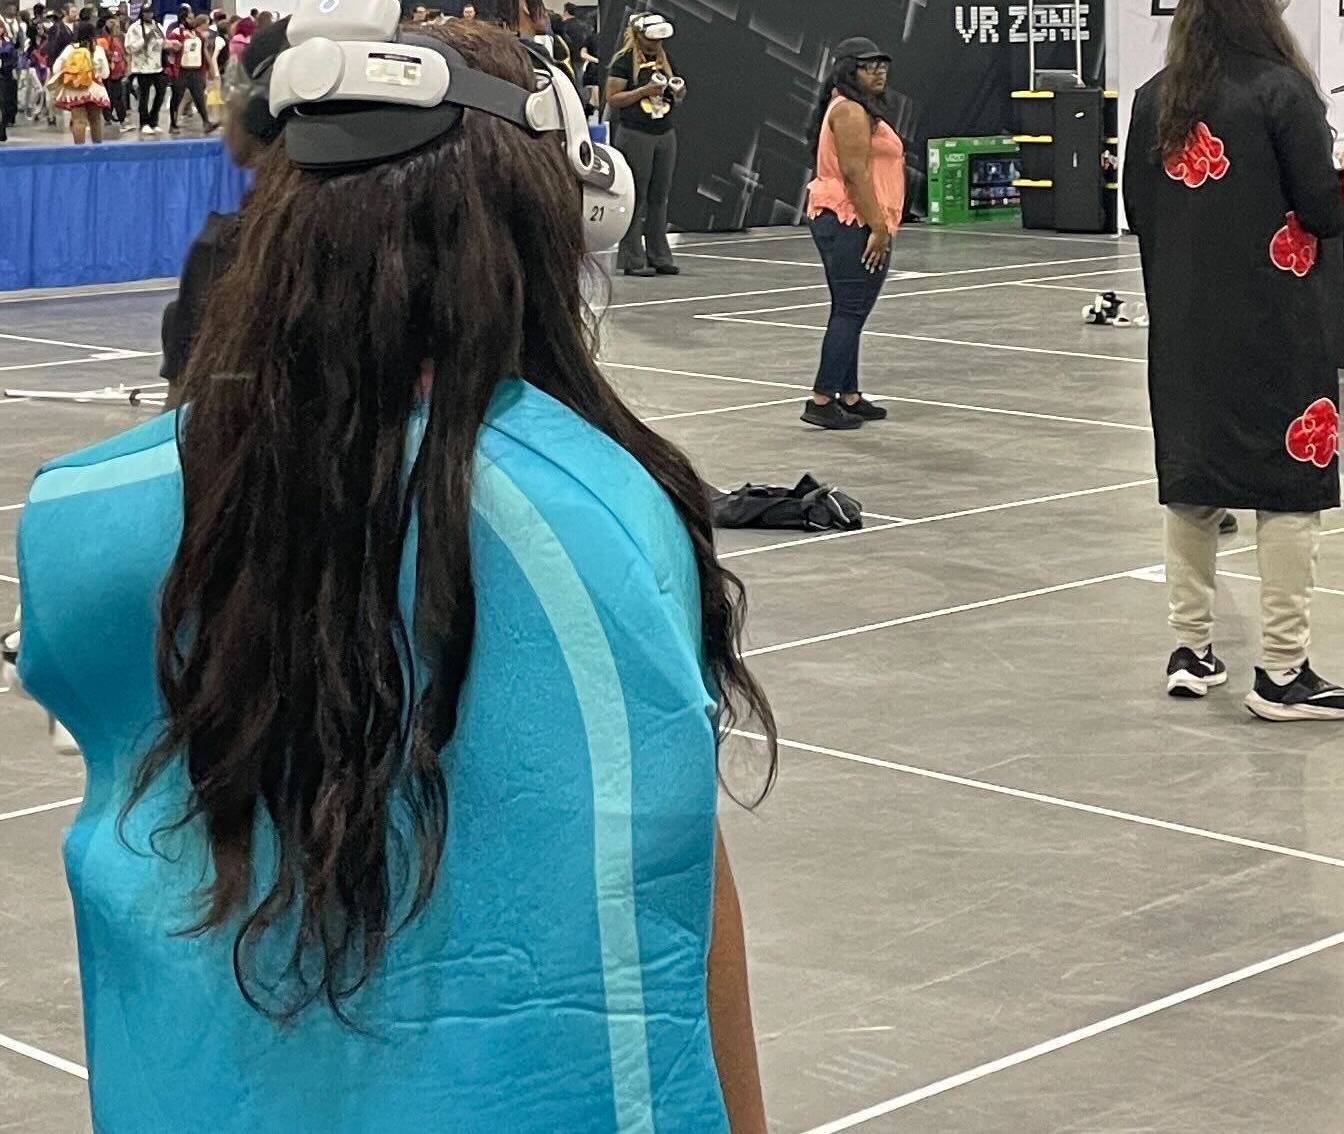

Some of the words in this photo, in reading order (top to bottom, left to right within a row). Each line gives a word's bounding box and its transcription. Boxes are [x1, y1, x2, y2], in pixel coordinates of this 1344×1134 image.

[955, 6, 999, 44] VR
[1008, 4, 1090, 43] ZONE
[589, 205, 605, 222] 21
